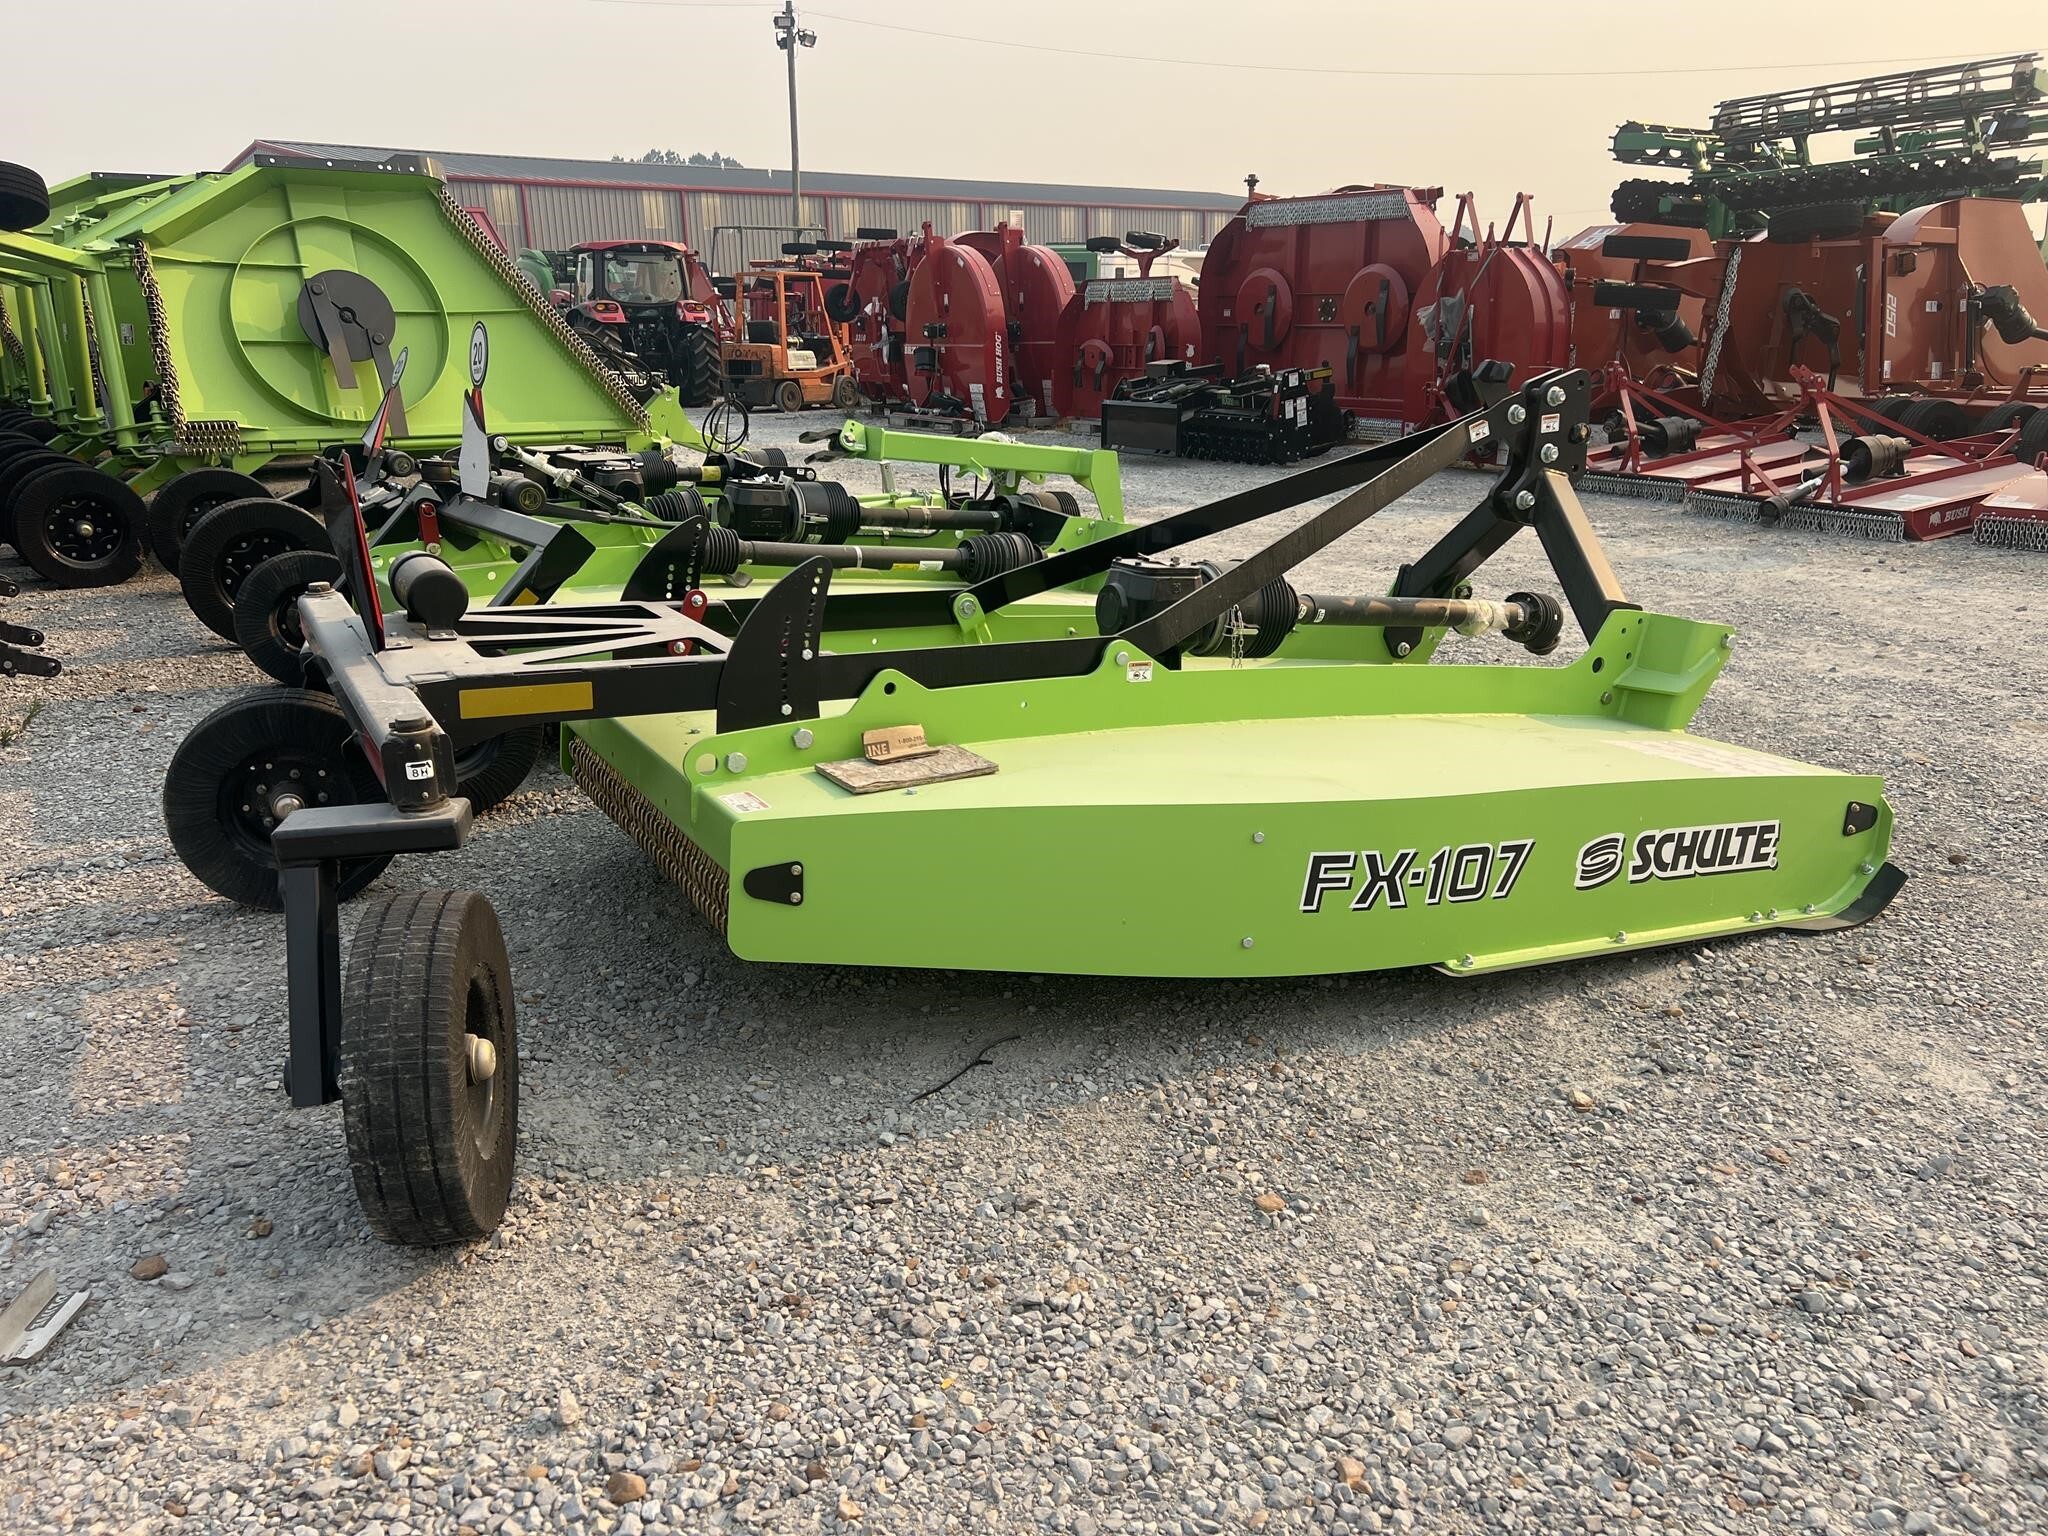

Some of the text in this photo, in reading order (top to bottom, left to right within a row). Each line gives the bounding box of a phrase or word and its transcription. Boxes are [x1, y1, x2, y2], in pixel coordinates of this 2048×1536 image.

[1885, 293, 1897, 337] 2150
[473, 342, 483, 366] 20
[1944, 506, 1971, 522] BUSH
[1629, 821, 1778, 882] SCHULTE
[1299, 838, 1537, 913] FX-107
